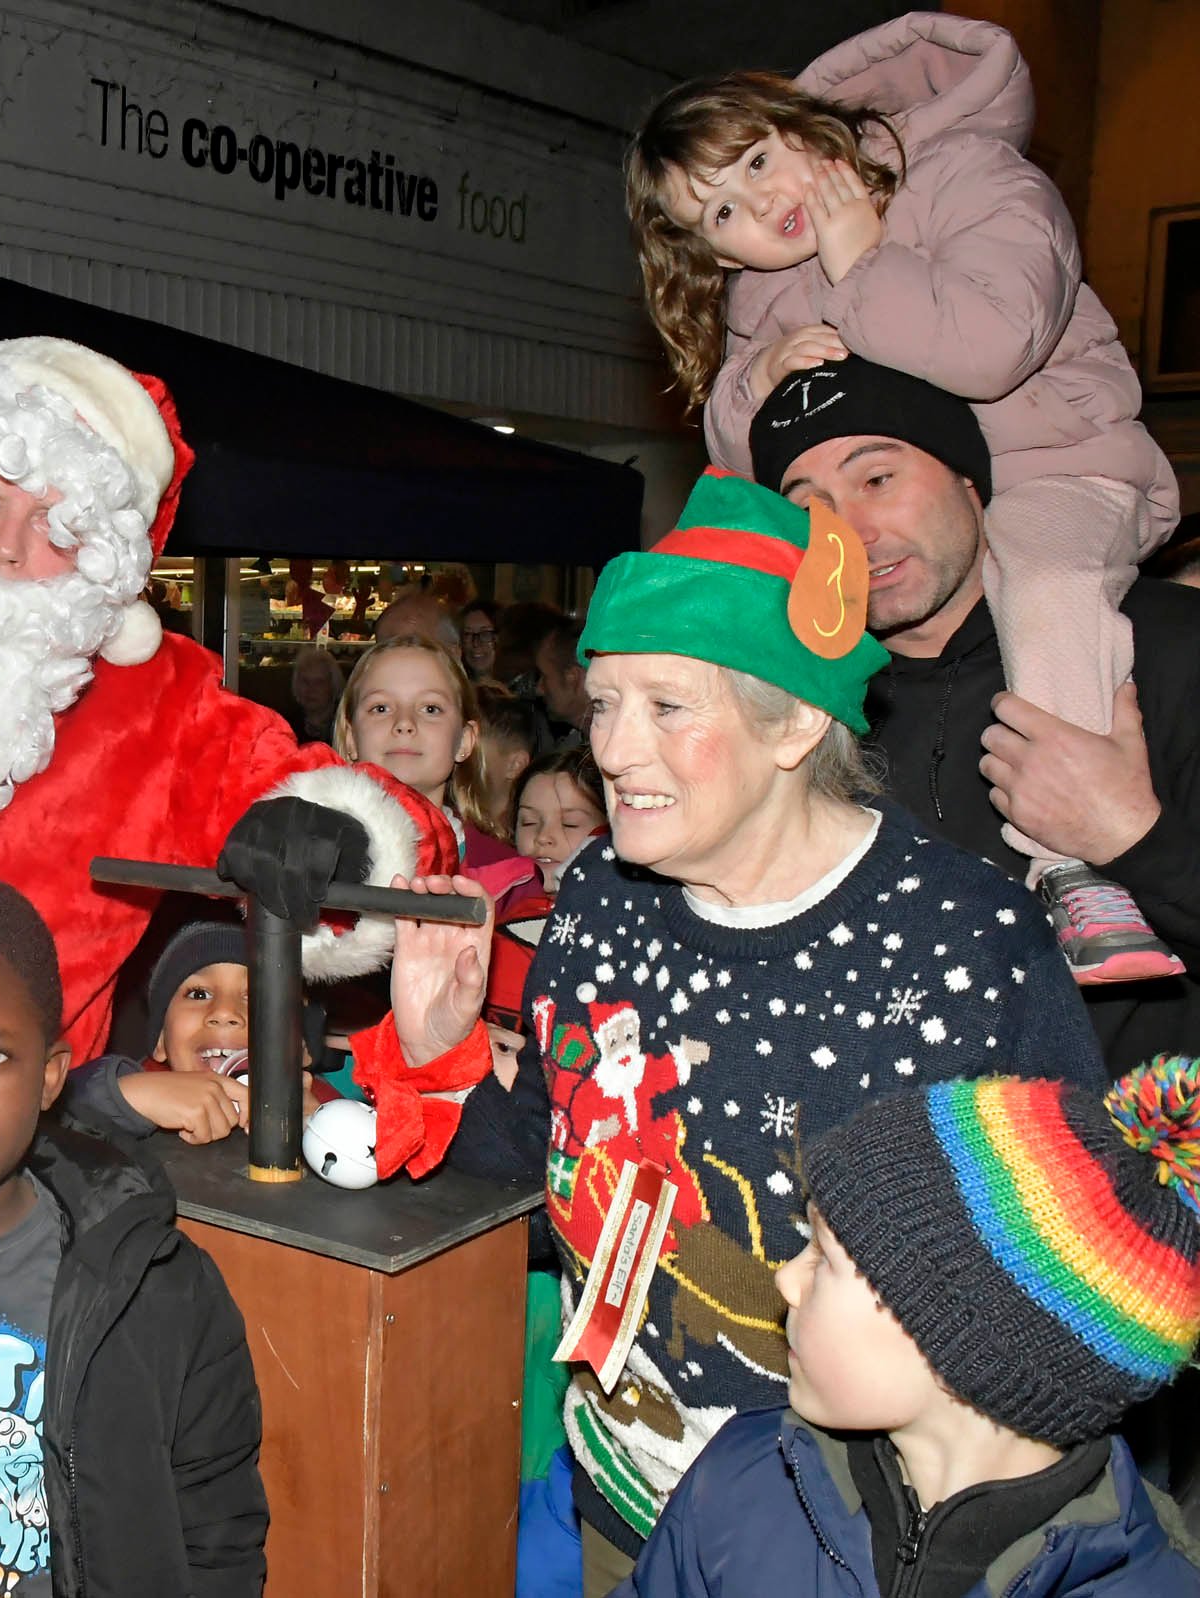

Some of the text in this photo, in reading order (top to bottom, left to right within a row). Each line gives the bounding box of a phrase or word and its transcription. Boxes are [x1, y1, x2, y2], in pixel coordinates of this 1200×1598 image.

[90, 77, 528, 244] The co-operative food
[611, 1213, 643, 1296] Santa's Elf
